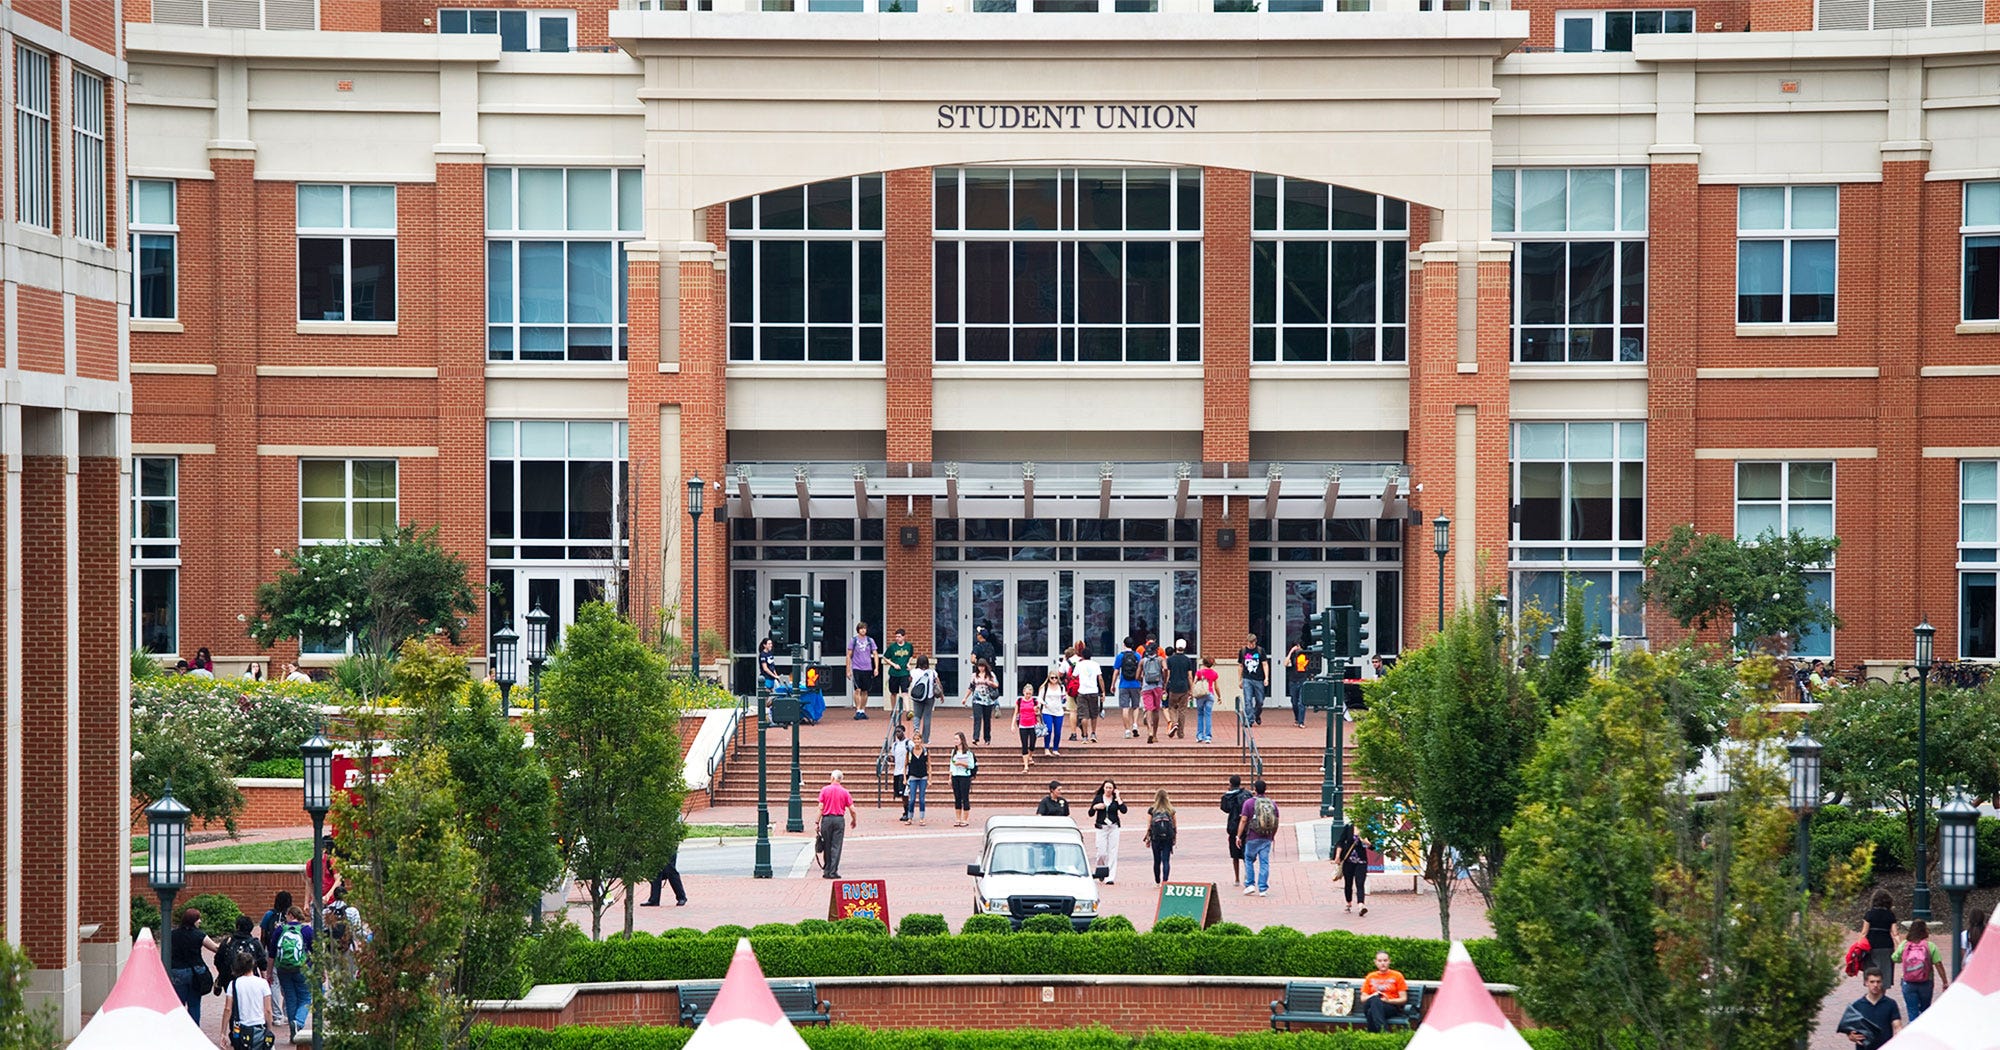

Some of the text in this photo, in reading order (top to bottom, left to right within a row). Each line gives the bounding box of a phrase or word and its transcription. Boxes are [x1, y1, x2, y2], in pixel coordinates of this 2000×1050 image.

[937, 104, 1199, 129] STUDENT UNION
[842, 882, 879, 900] RUSH
[1165, 884, 1206, 897] RUSH
